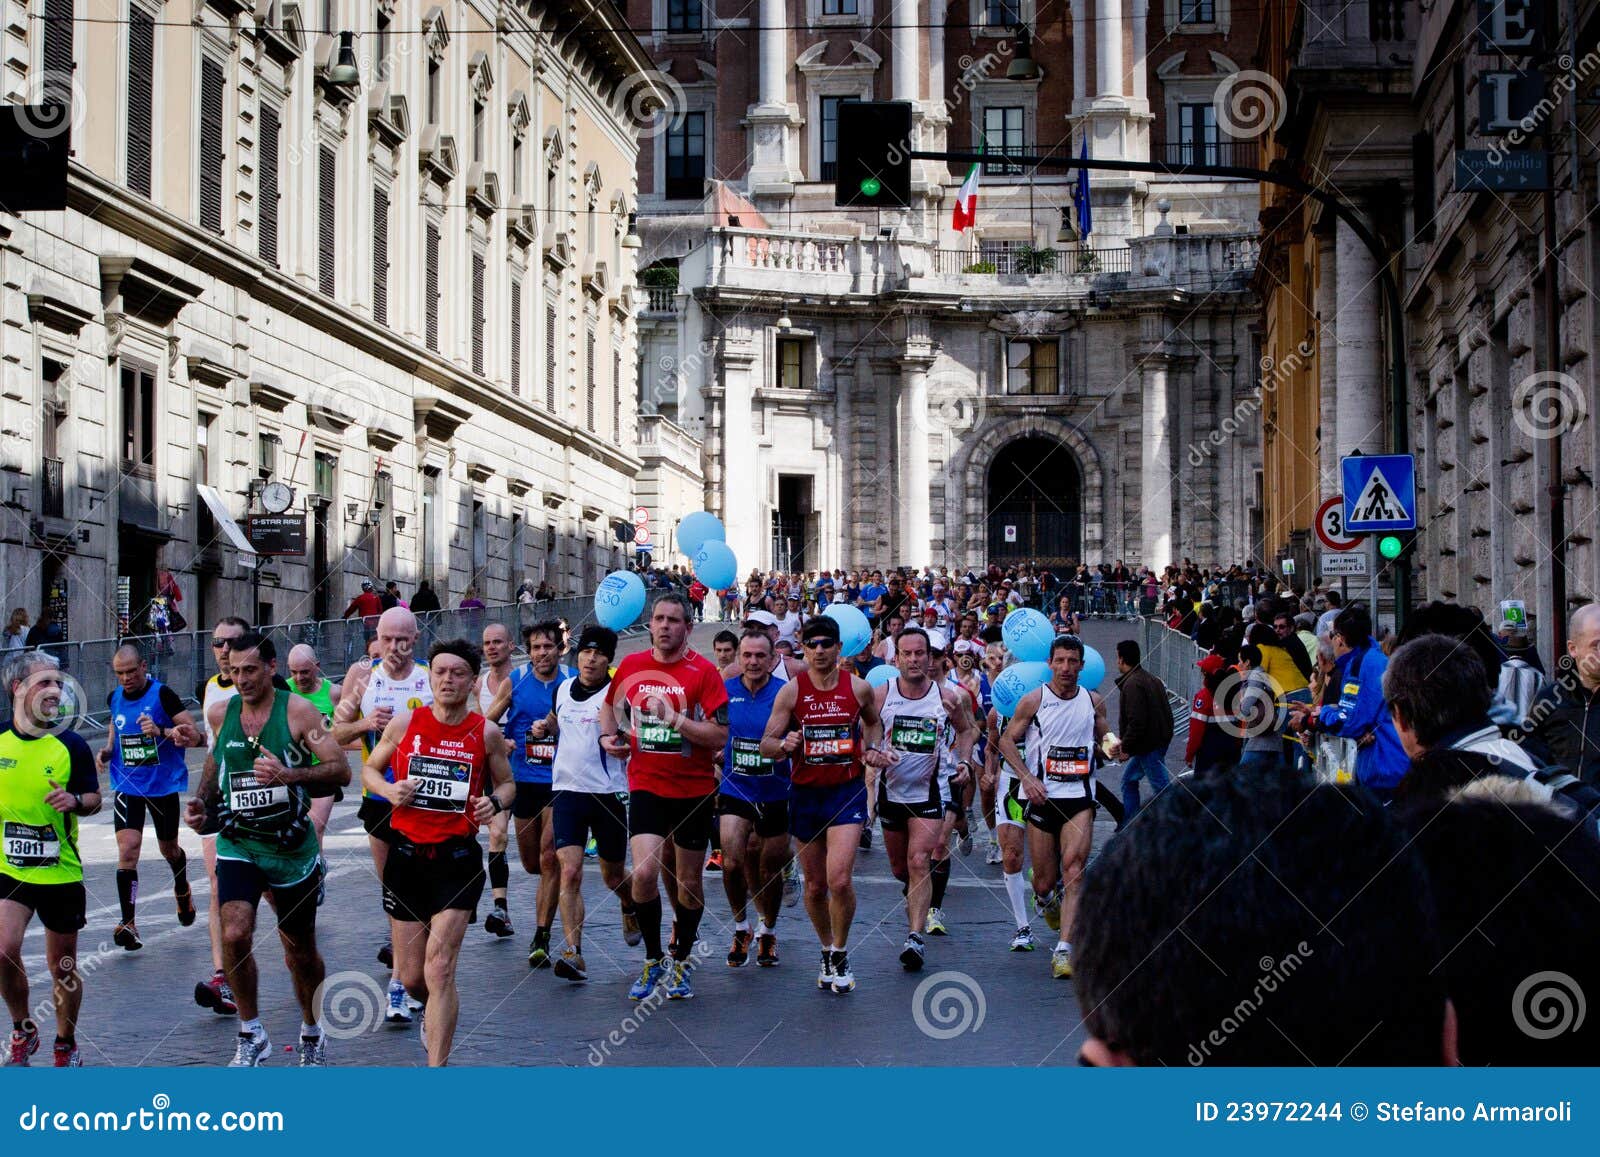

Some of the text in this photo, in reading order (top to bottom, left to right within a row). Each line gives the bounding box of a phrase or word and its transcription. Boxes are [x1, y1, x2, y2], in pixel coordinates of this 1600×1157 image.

[638, 684, 685, 695] DENMARK
[810, 701, 837, 711] GATE
[440, 740, 464, 748] ATLETICA
[810, 740, 839, 755] 2264
[532, 745, 555, 757] 1979
[413, 778, 452, 797] 2915
[235, 789, 273, 807] 15037
[9, 840, 45, 856] 13011
